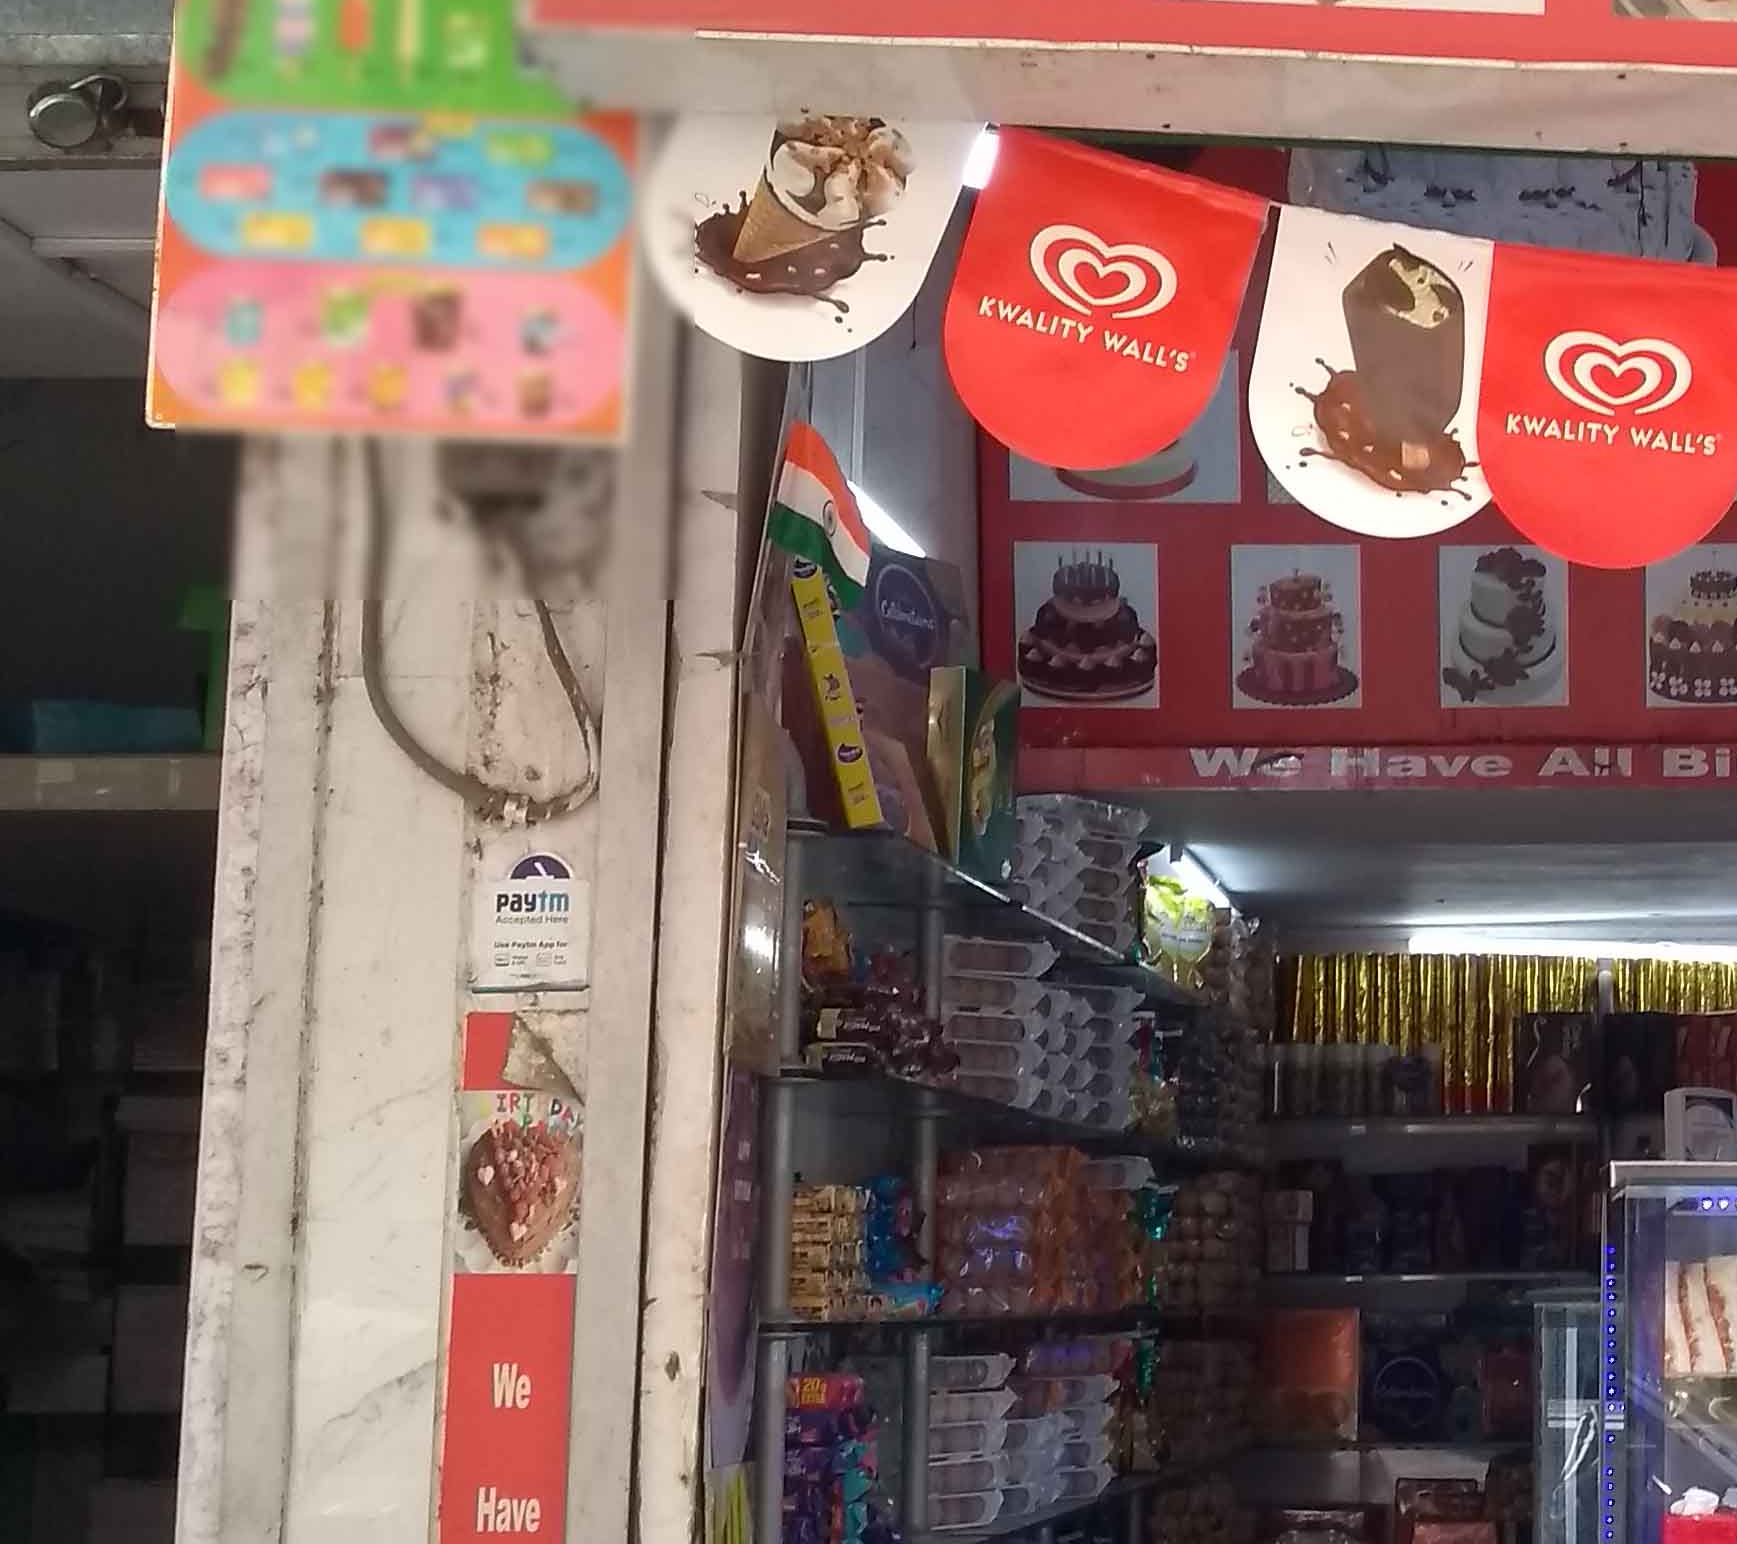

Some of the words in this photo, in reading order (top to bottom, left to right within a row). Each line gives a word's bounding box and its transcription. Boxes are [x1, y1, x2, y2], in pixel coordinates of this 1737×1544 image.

[978, 294, 1094, 344] KWALITY
[1104, 329, 1189, 372] WALL'S
[1505, 412, 1618, 447] KWALITY
[1630, 427, 1717, 457] WALL'S
[1330, 745, 1514, 778] Have
[1538, 746, 1634, 778] All
[496, 889, 569, 913] paytm
[491, 1362, 532, 1410] We
[476, 1486, 541, 1534] Have
